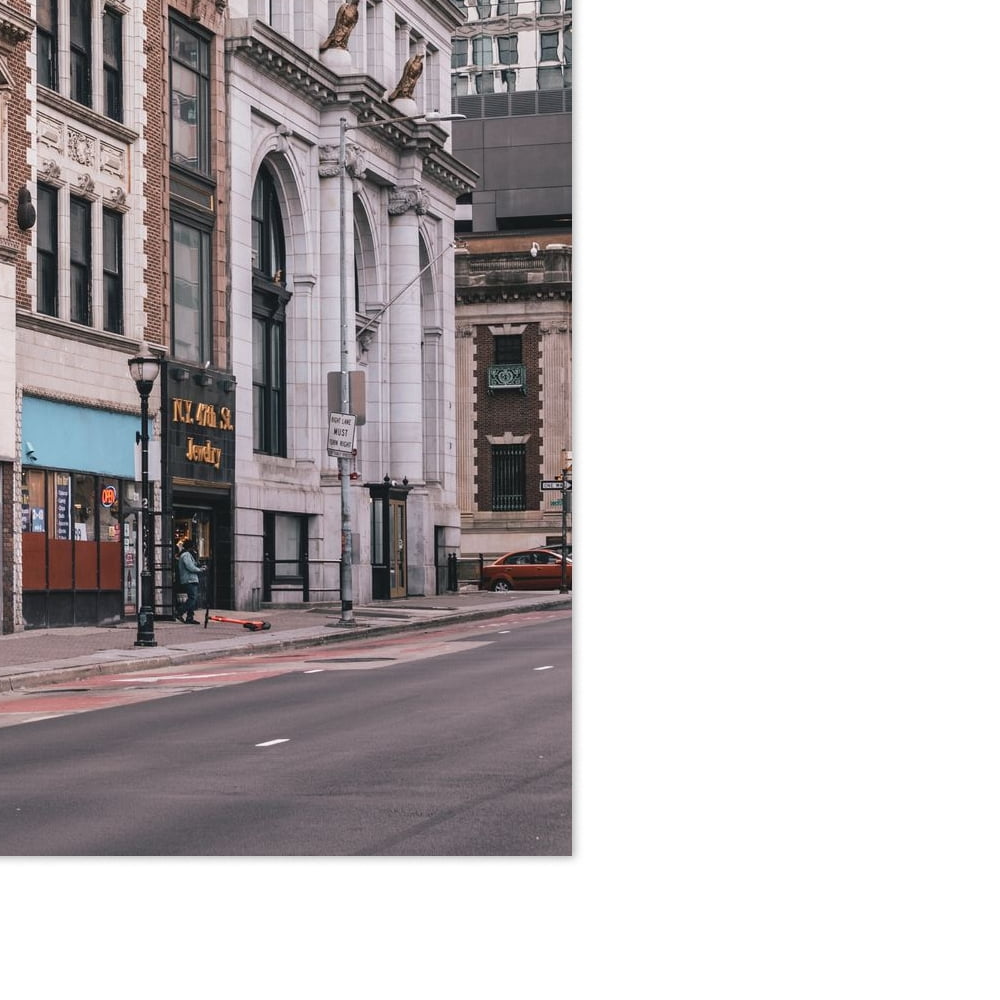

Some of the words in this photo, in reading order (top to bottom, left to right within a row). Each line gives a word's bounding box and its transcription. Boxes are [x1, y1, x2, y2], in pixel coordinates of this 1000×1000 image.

[172, 397, 195, 425] N.Y.
[220, 407, 234, 431] St.
[333, 427, 348, 437] MUST
[186, 436, 222, 469] Jewelry
[101, 488, 115, 504] OPEN
